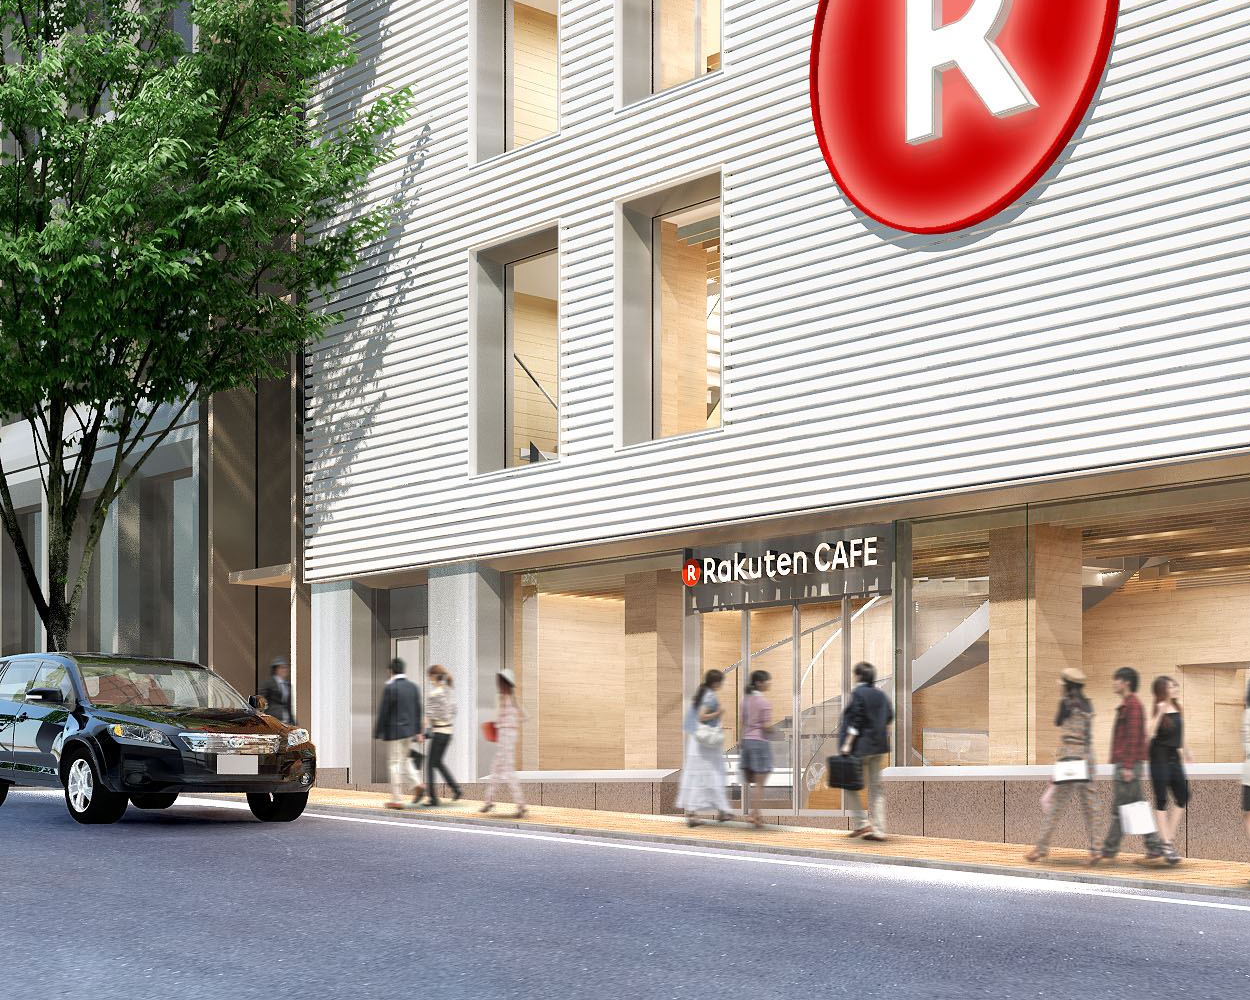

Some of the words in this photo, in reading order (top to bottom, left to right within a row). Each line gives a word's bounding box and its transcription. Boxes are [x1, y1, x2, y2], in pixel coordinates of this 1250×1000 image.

[687, 564, 697, 581] R
[703, 550, 808, 584] Rakuten
[814, 536, 878, 572] CAFE
